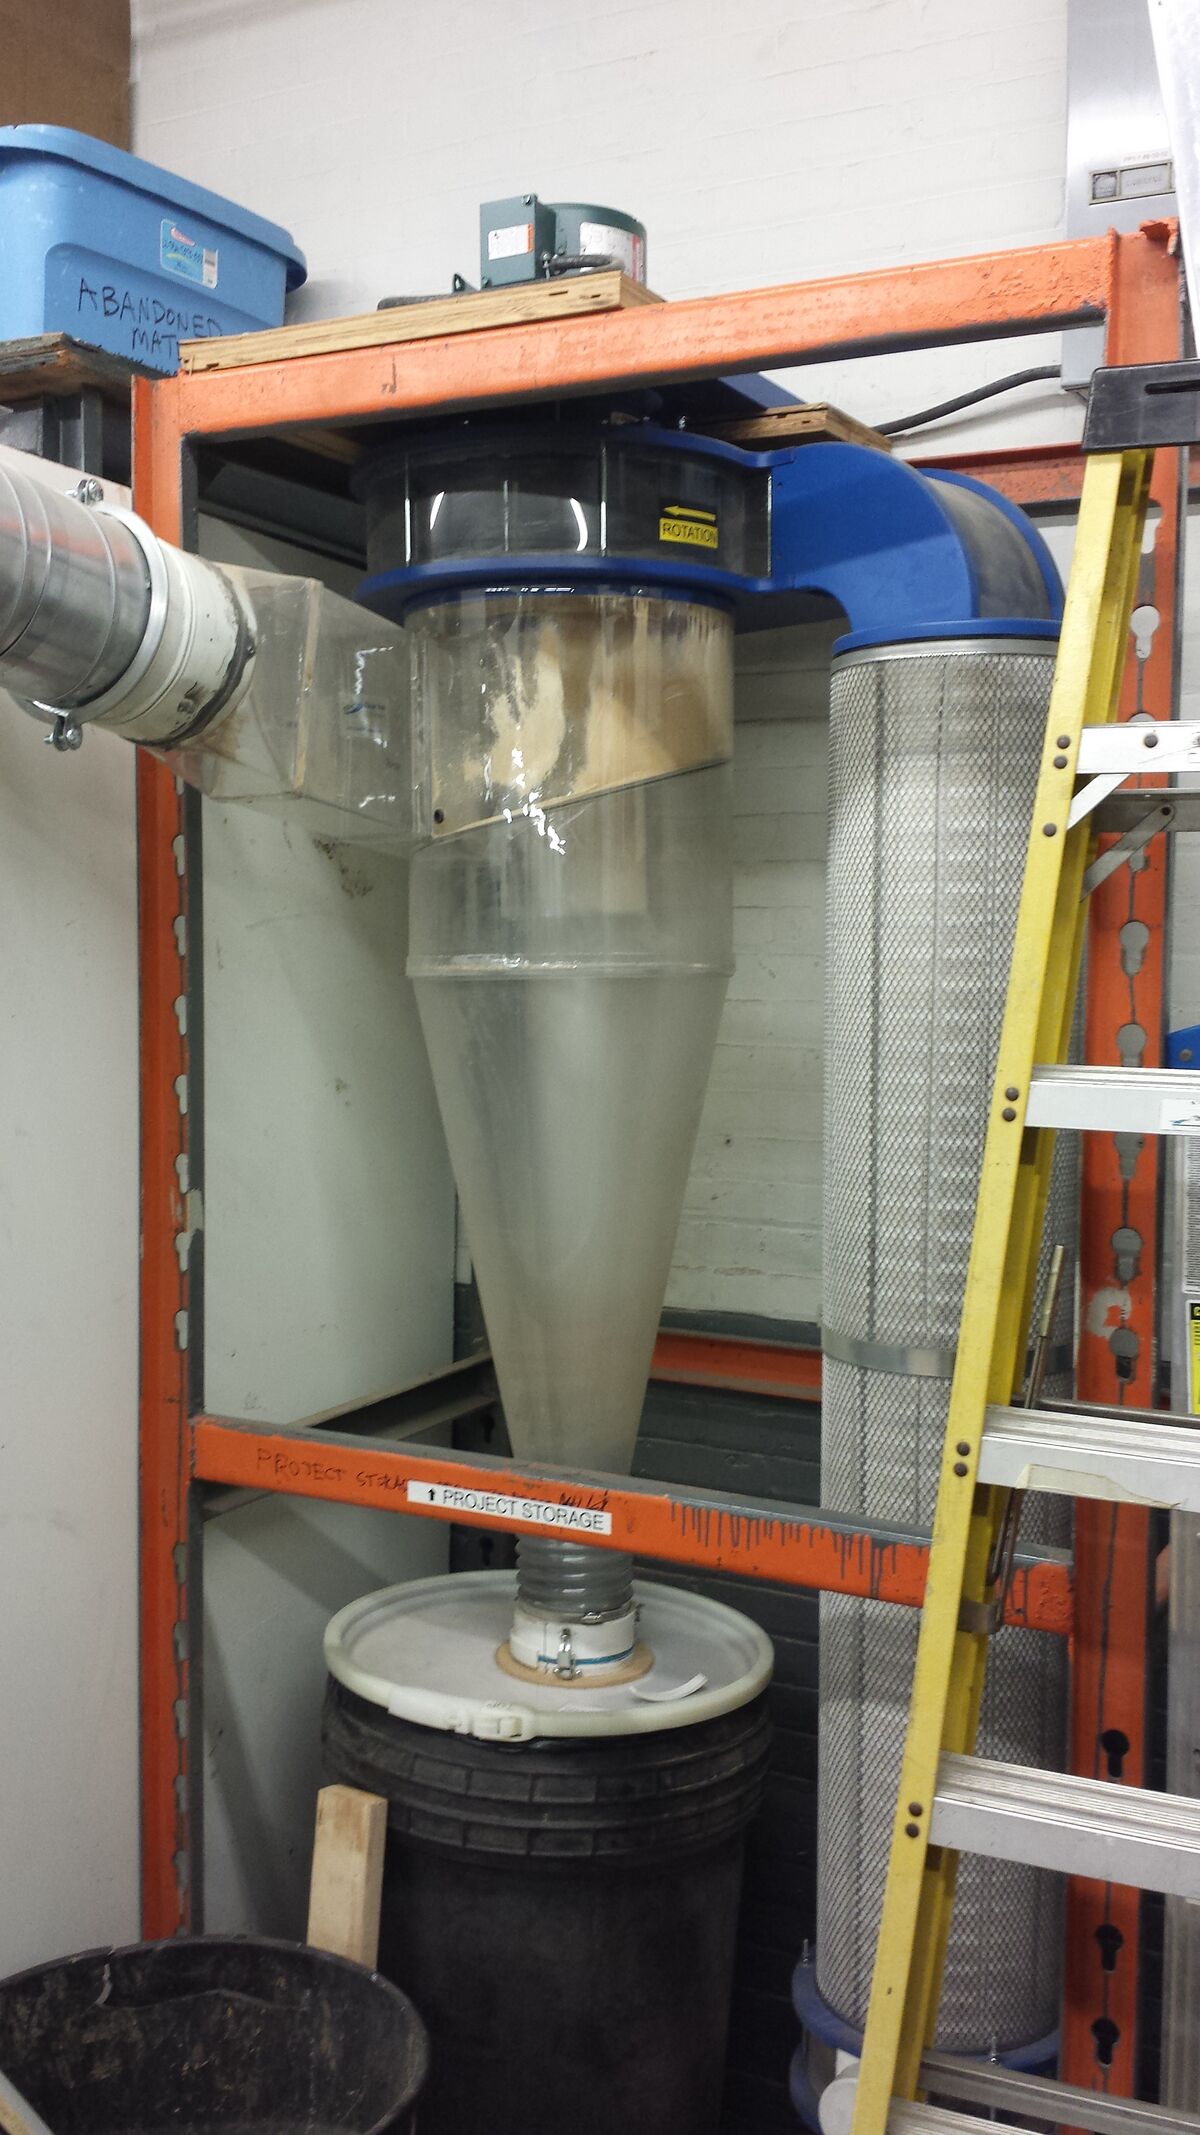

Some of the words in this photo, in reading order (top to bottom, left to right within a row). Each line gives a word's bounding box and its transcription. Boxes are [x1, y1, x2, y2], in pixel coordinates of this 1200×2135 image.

[77, 278, 223, 337] ABANDONED
[131, 328, 177, 358] MAT
[662, 522, 717, 544] ROTATION
[257, 1448, 345, 1482] PROJECT
[443, 1489, 517, 1515] PROJECT
[522, 1503, 605, 1531] STORAGE
